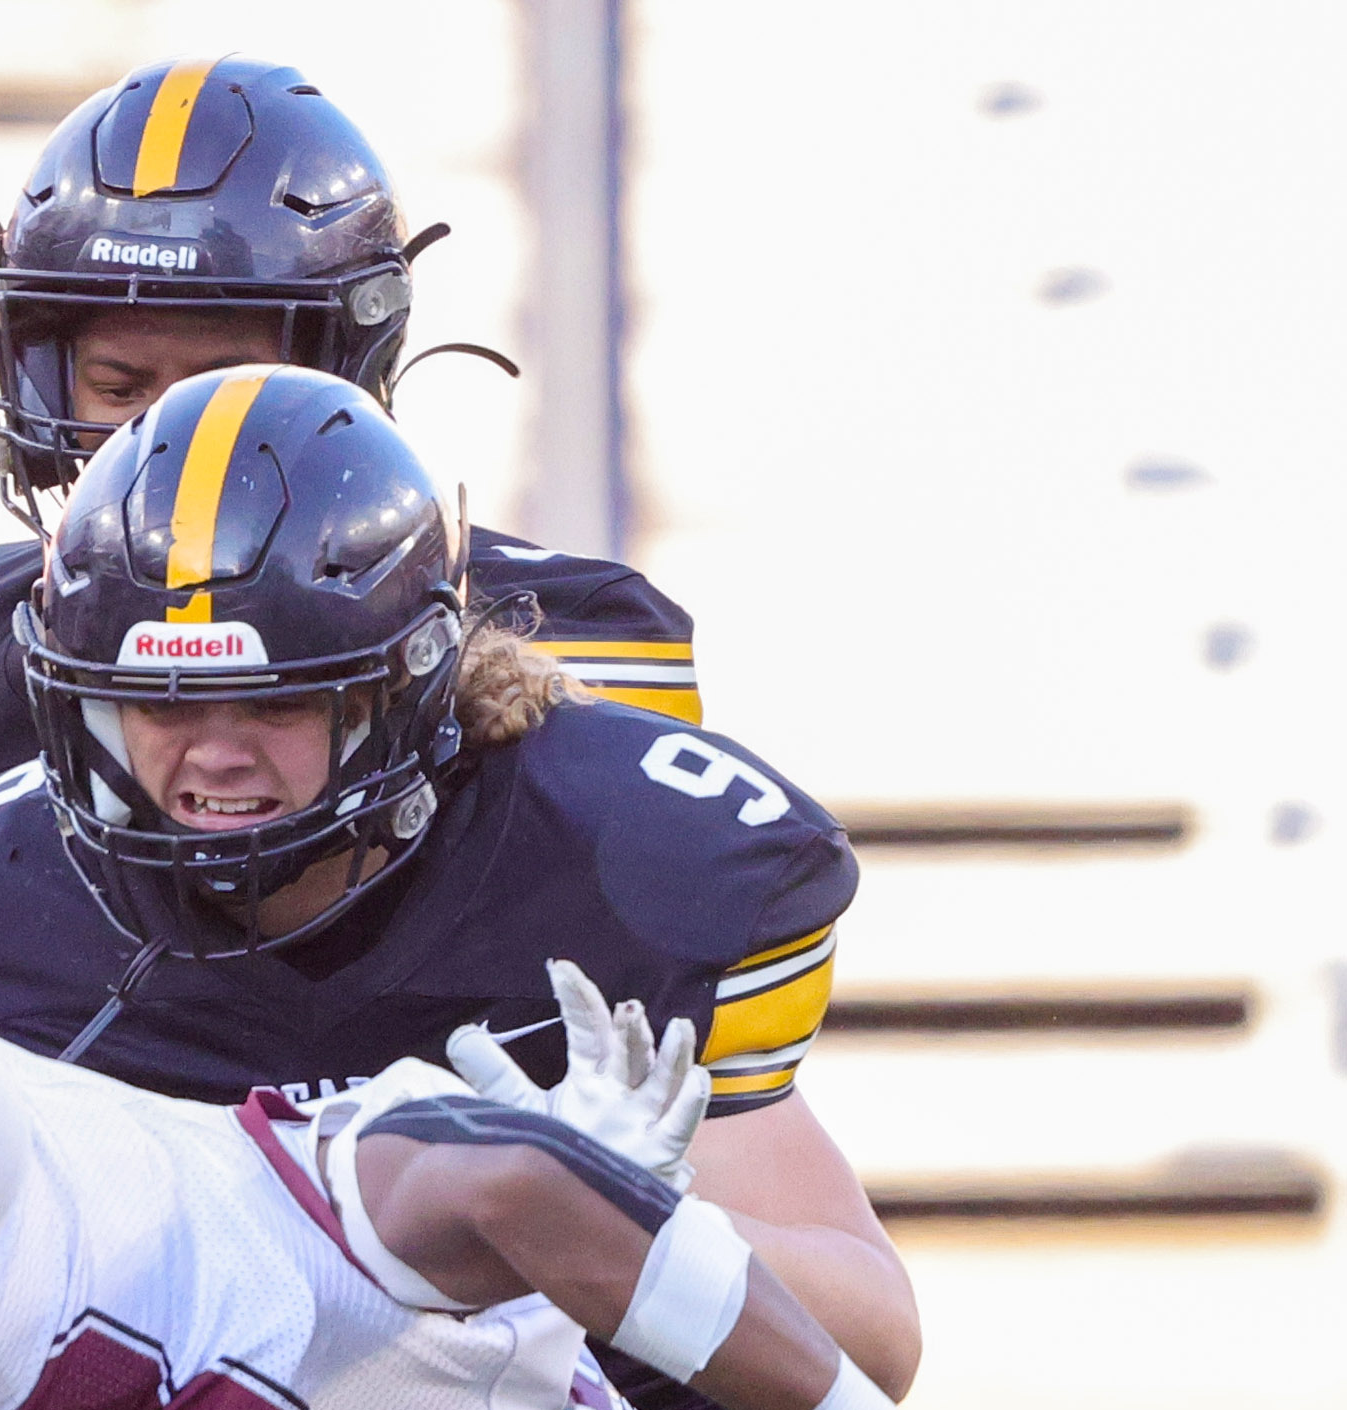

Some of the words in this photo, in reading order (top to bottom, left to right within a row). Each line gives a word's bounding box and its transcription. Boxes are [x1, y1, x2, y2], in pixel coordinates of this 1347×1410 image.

[91, 237, 198, 270] Riddell
[136, 633, 244, 657] Riddell
[639, 732, 792, 828] 9
